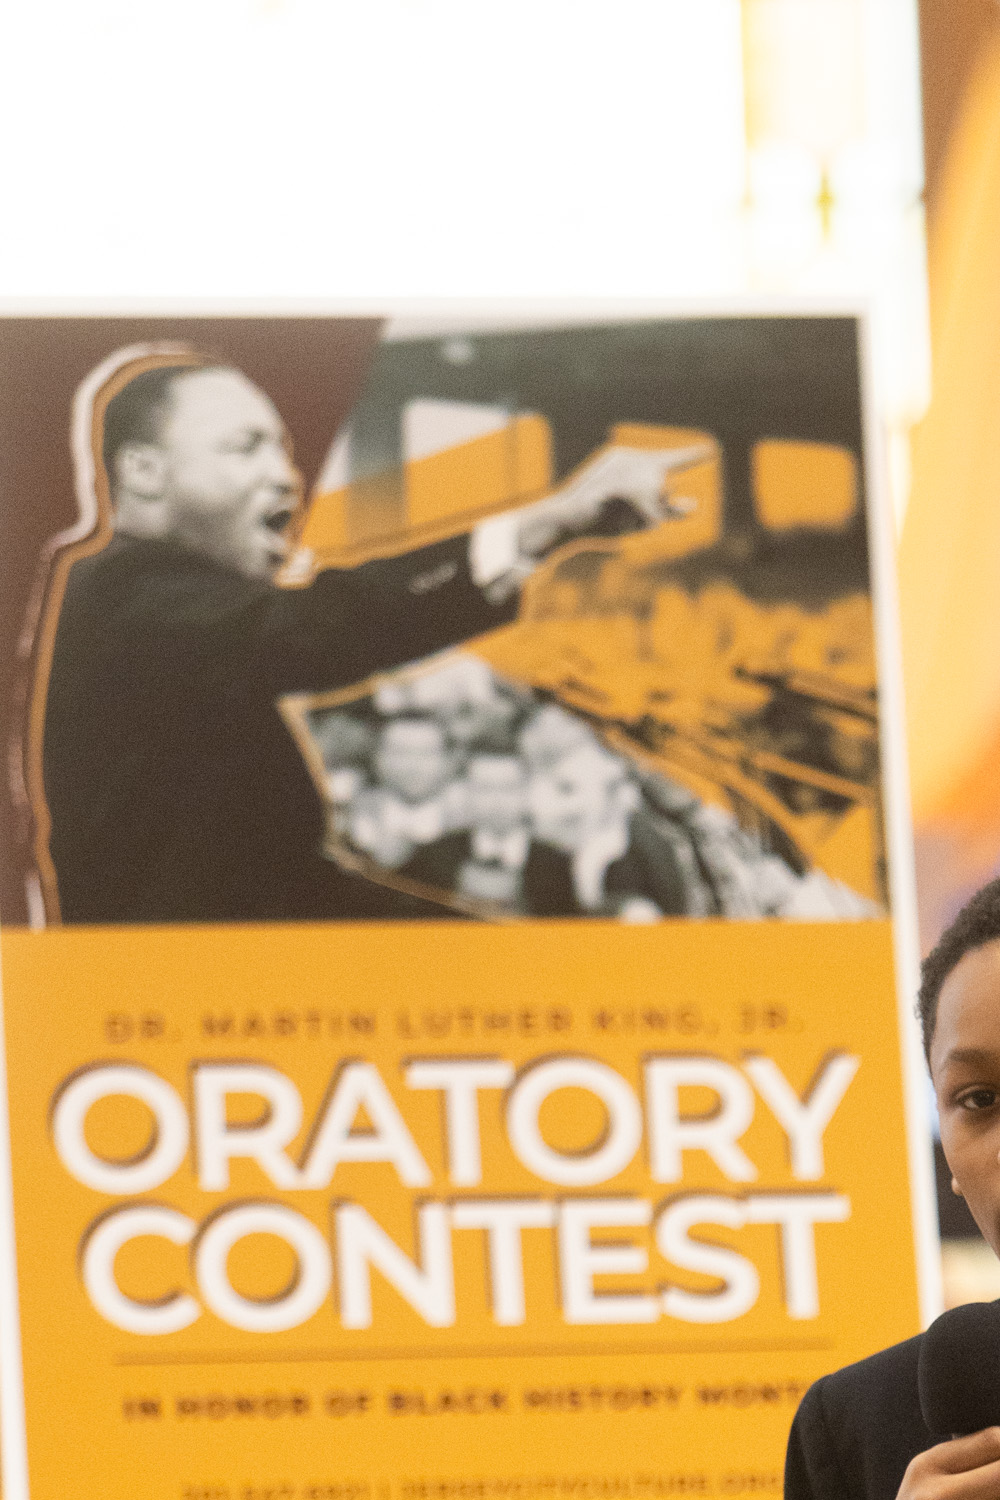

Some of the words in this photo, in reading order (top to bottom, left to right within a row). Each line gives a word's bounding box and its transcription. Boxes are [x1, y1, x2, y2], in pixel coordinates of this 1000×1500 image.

[202, 1010, 377, 1040] MARTIN
[396, 1005, 571, 1039] LUTHER
[52, 1052, 859, 1194] ORATORY
[81, 1192, 851, 1335] CONTEST
[122, 1394, 162, 1421] IN
[176, 1391, 311, 1420] HONOR
[324, 1389, 370, 1418] OF
[388, 1386, 506, 1416] BLACK
[525, 1383, 682, 1413] HISTORY
[697, 1380, 806, 1410] MONT
